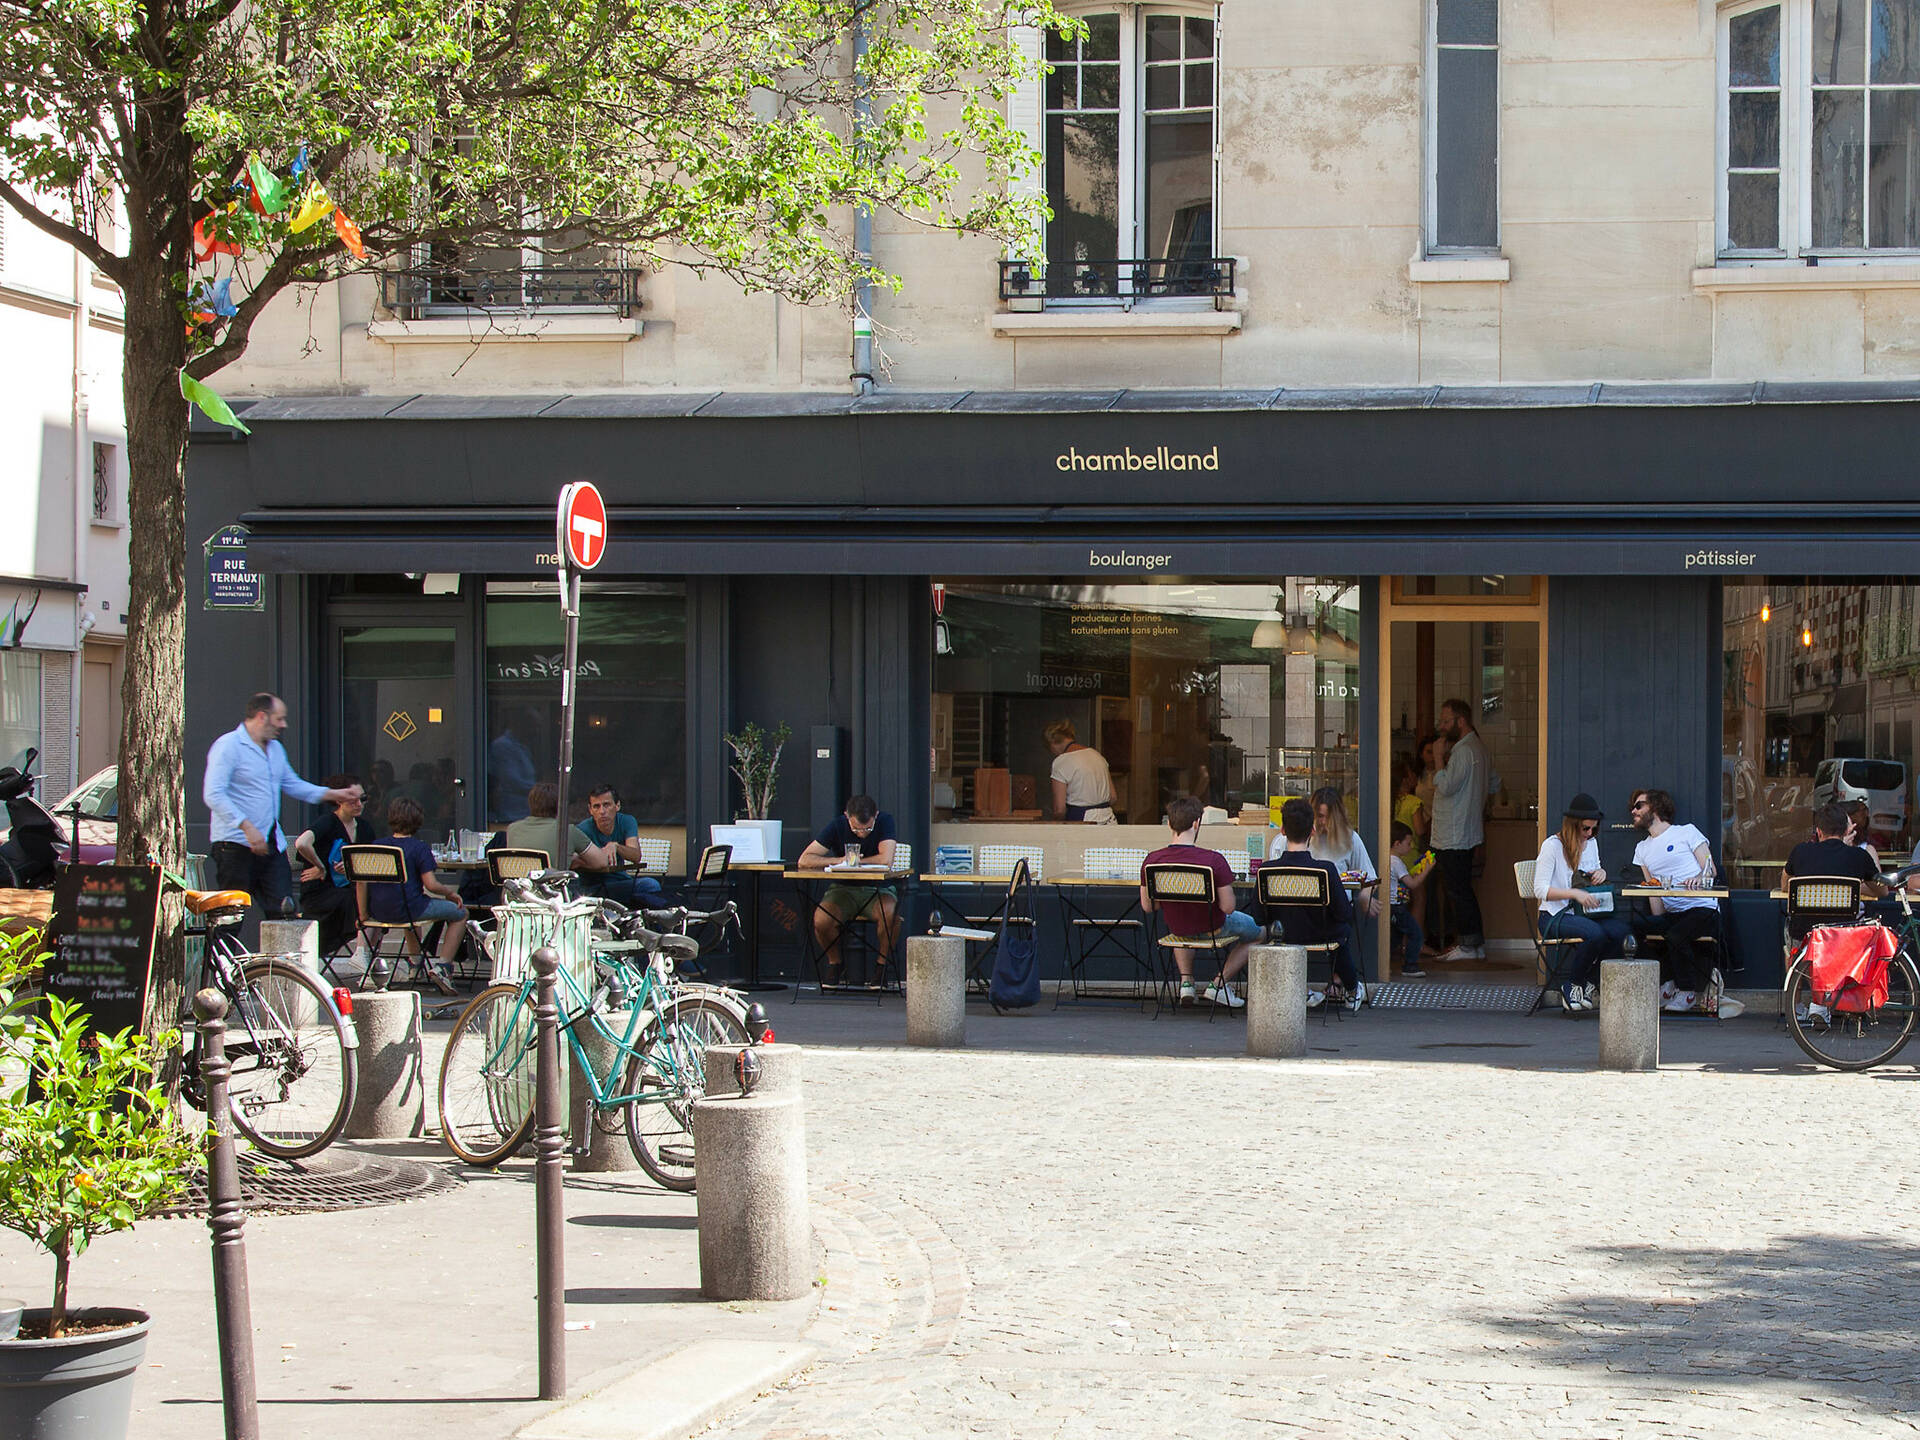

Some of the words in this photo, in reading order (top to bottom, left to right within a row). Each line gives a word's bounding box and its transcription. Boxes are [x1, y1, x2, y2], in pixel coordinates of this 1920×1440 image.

[1056, 446, 1219, 471] chambelland
[535, 553, 559, 565] me
[1089, 550, 1172, 570] boulanger
[1685, 551, 1757, 569] pâtissier
[224, 560, 246, 570] RUE
[211, 573, 258, 583] TERNAUX
[1071, 613, 1119, 624] producteur
[1120, 613, 1131, 622] de
[1133, 613, 1162, 622] farines
[1071, 625, 1130, 635] naturellement
[1131, 627, 1151, 635] sans
[1152, 625, 1179, 636] gluten
